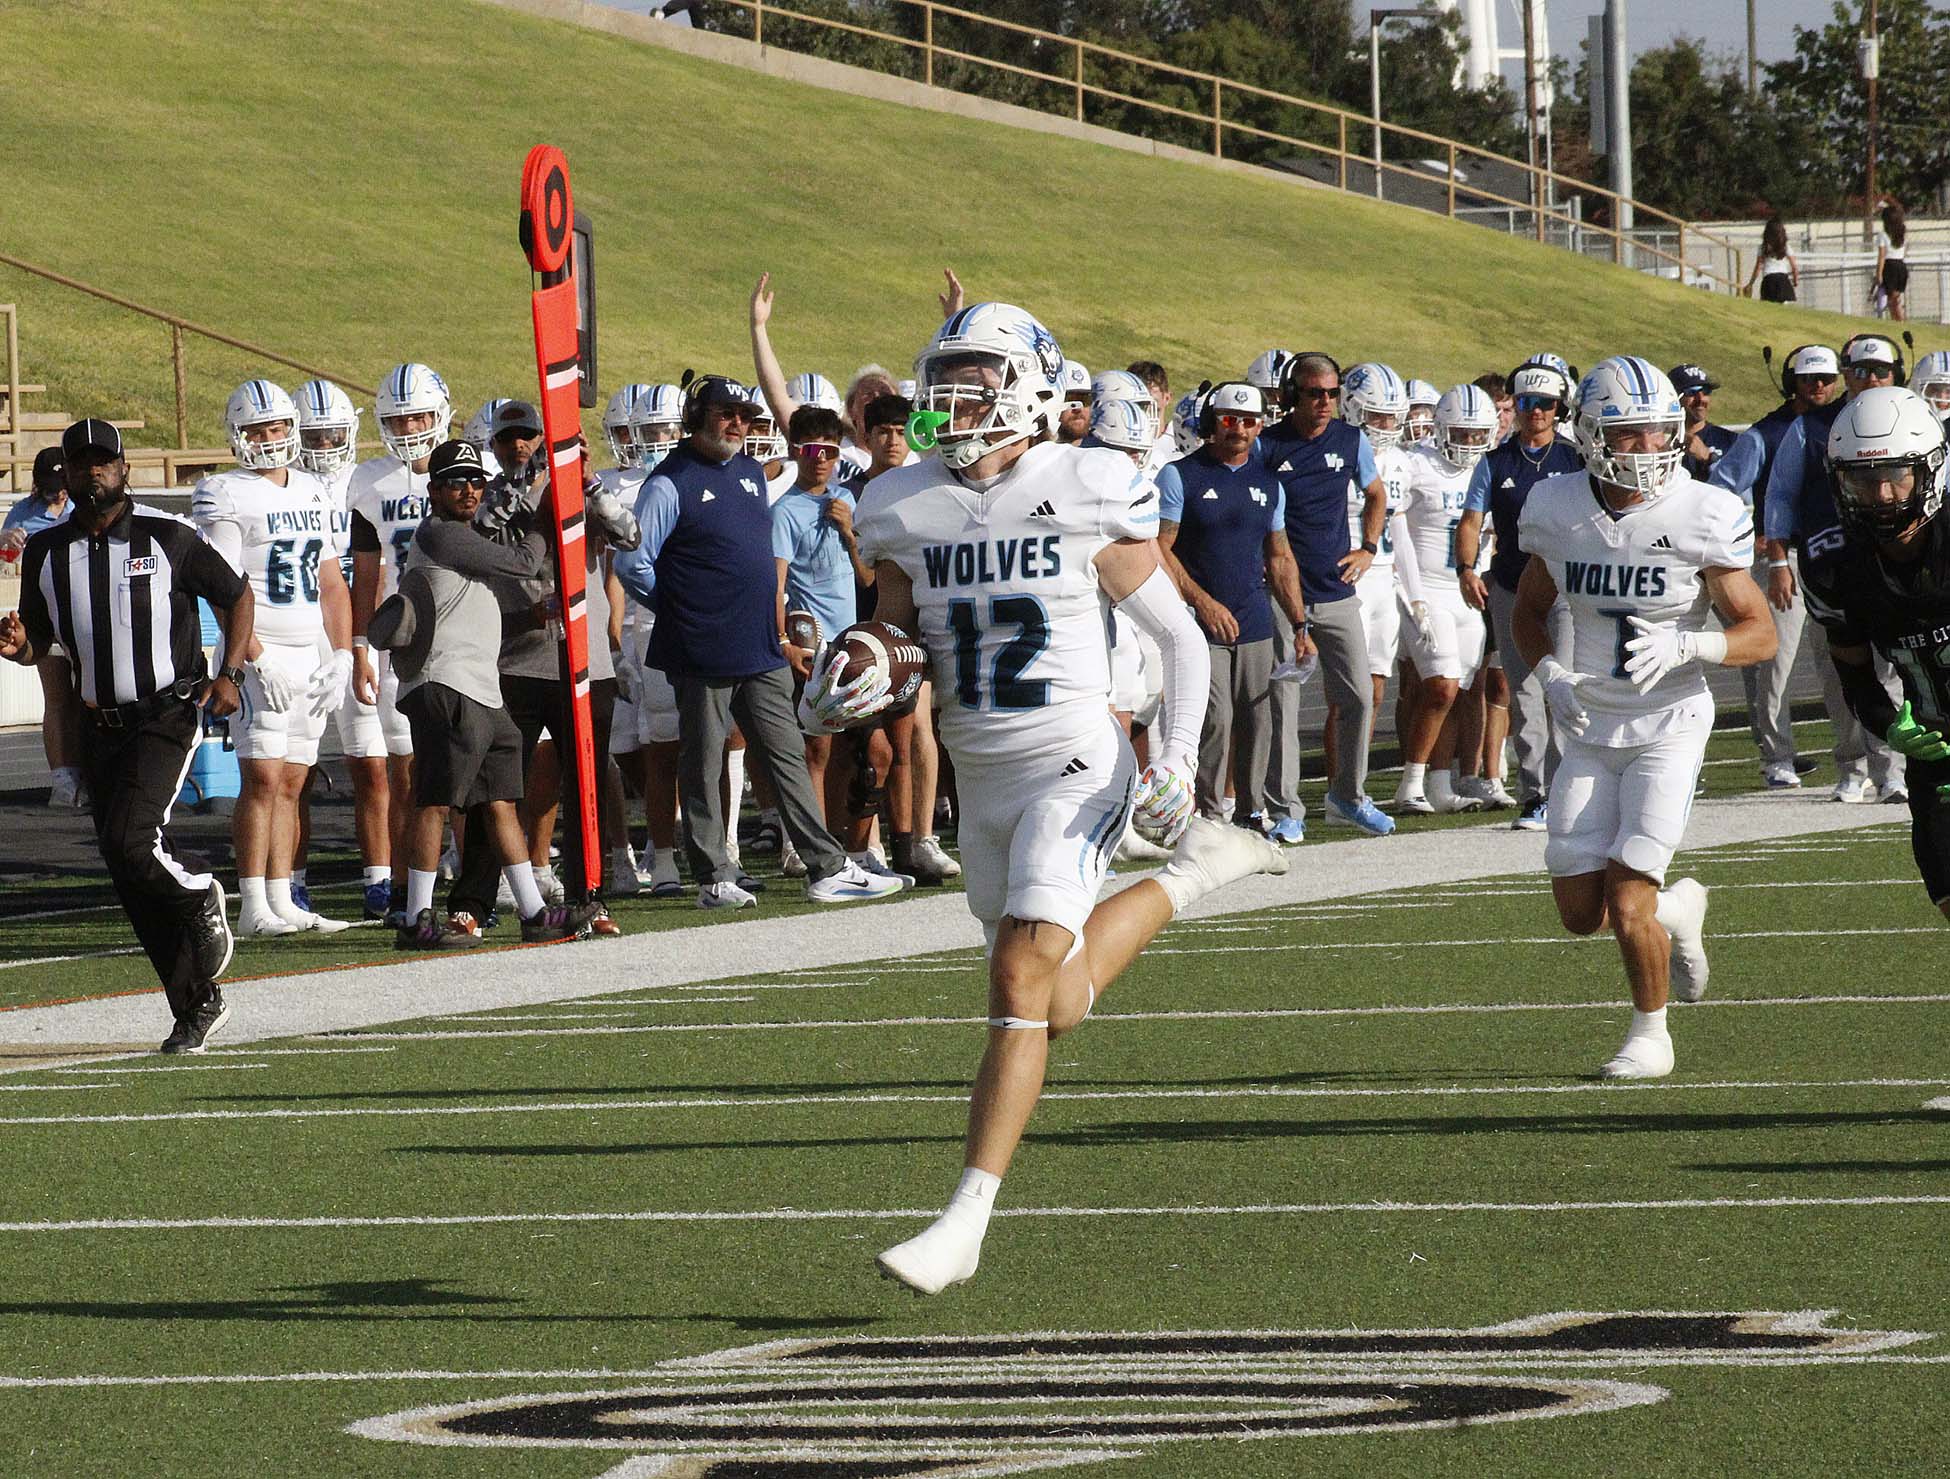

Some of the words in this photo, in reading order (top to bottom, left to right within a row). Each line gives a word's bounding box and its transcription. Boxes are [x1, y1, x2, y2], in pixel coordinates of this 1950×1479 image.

[454, 443, 479, 461] A
[1856, 448, 1888, 458] Riddell
[266, 510, 322, 535] WOLVES
[922, 534, 1061, 589] WOLVES
[1564, 560, 1667, 598] WOLVES
[946, 592, 1051, 713] 12
[1897, 633, 1927, 649] THE
